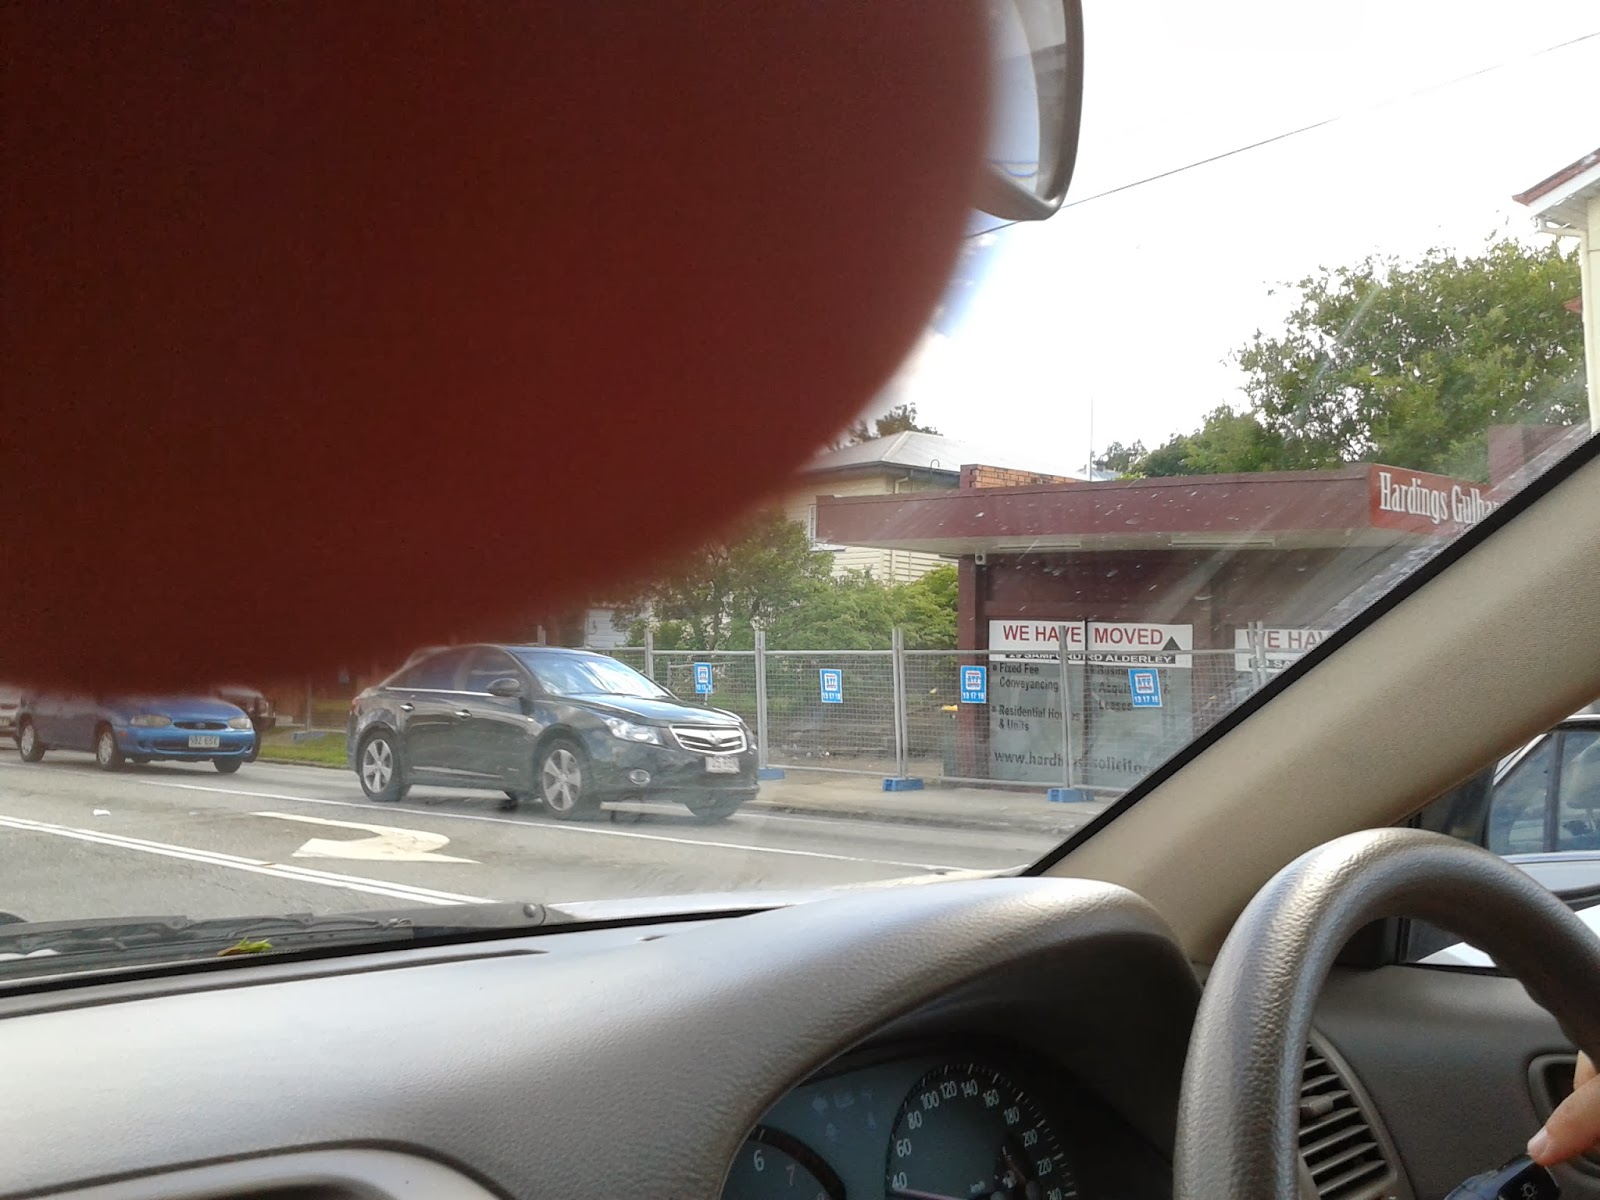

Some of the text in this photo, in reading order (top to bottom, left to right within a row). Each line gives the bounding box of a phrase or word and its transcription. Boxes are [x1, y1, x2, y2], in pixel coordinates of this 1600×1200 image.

[1379, 472, 1448, 524] Hardings
[1003, 625, 1029, 641] WE
[1094, 627, 1163, 645] MOVED
[1105, 654, 1172, 664] ALDERLEY
[1000, 662, 1039, 675] Fixed Fee
[1000, 676, 1059, 693] Conveyancing
[999, 704, 1046, 718] Residential
[1008, 719, 1030, 732] Units
[941, 1081, 957, 1099] 120
[961, 1079, 978, 1098] 140
[921, 1090, 939, 1109] 100
[983, 1089, 999, 1107] 160
[907, 1111, 922, 1129] 80
[897, 1138, 911, 1157] 60
[1023, 1129, 1038, 1148] 200
[753, 1150, 765, 1171] 6
[1037, 1158, 1052, 1176] 220
[892, 1172, 907, 1191] 40
